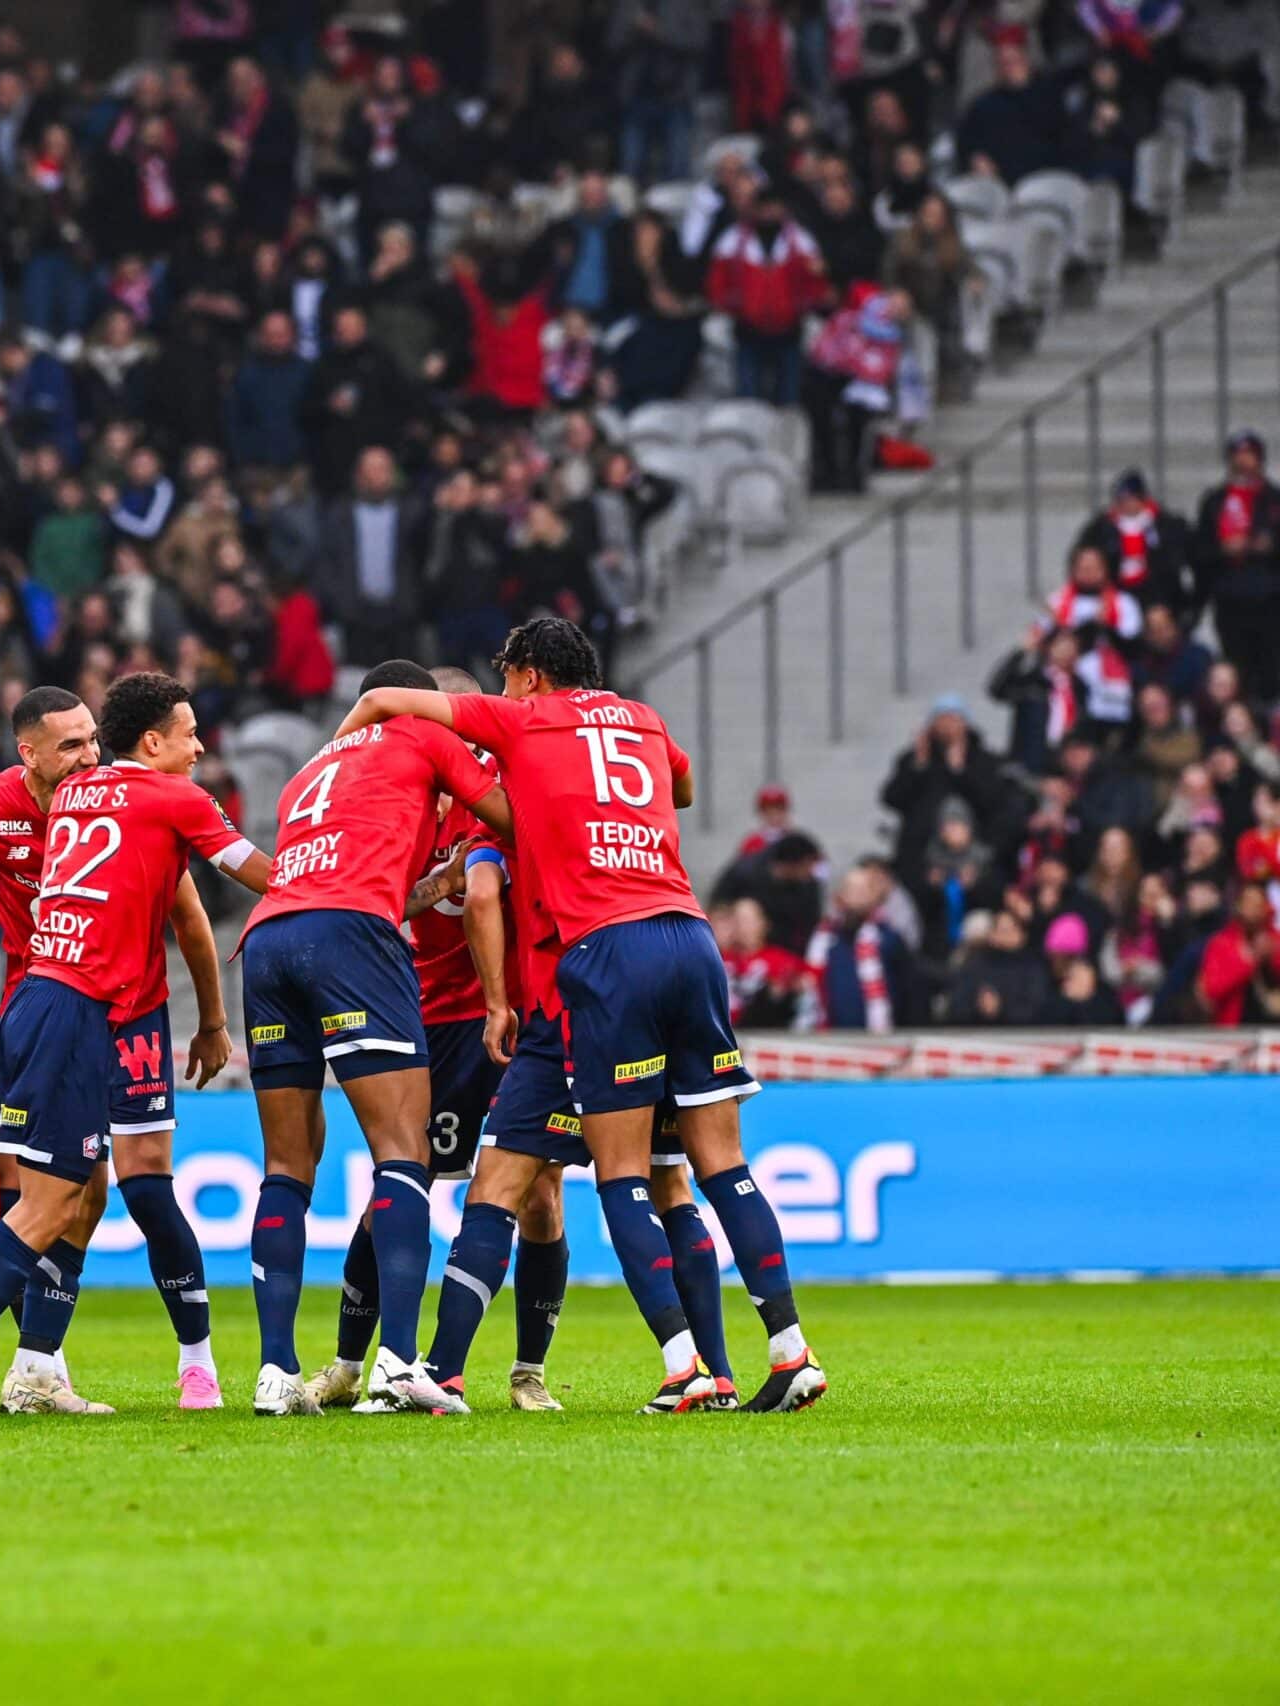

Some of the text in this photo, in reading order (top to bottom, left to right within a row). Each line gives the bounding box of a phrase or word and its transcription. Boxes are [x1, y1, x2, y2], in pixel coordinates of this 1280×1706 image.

[575, 727, 654, 807] 15
[286, 761, 341, 826] 4
[273, 830, 345, 872] TEDDY
[586, 821, 665, 850] TEDDY
[40, 816, 122, 902] 22
[269, 852, 339, 888] SMITH
[589, 846, 665, 874] SMITH
[39, 910, 95, 939] EDDY
[426, 1111, 461, 1156] 3
[44, 1286, 76, 1306] LOSC
[161, 1271, 195, 1290] LOSC
